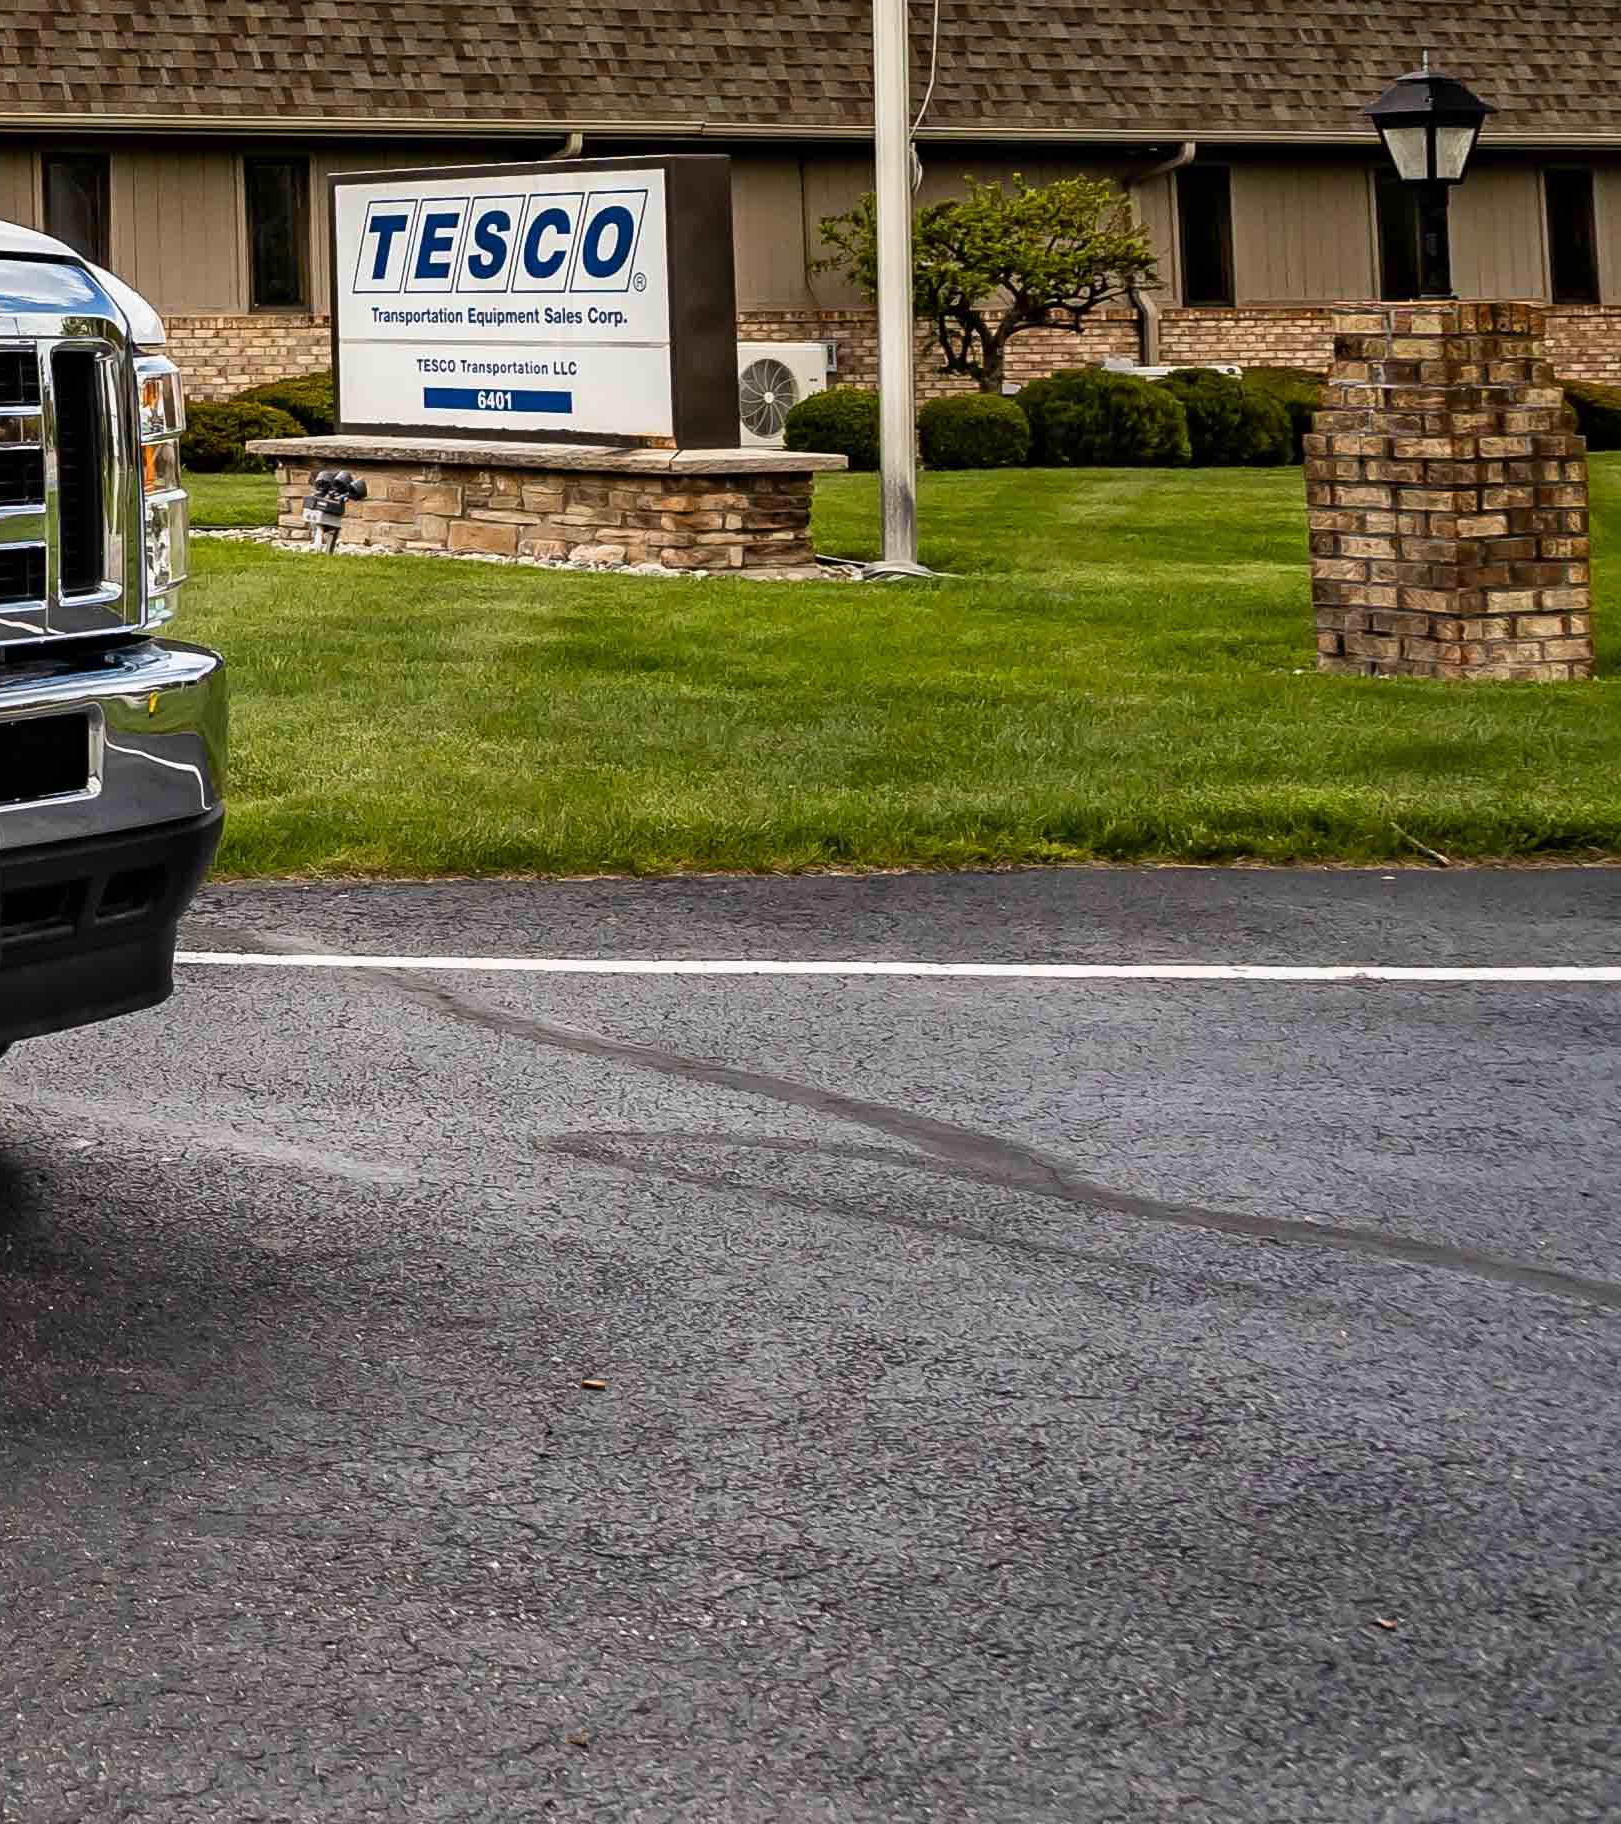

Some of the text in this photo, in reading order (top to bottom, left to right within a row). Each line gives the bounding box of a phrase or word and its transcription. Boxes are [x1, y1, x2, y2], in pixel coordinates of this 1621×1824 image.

[369, 206, 635, 279] TESCO
[371, 307, 628, 327] Transportation Equipment Sales Corp.
[417, 359, 577, 376] TESCO Transportation LLC
[477, 391, 512, 410] 6401
